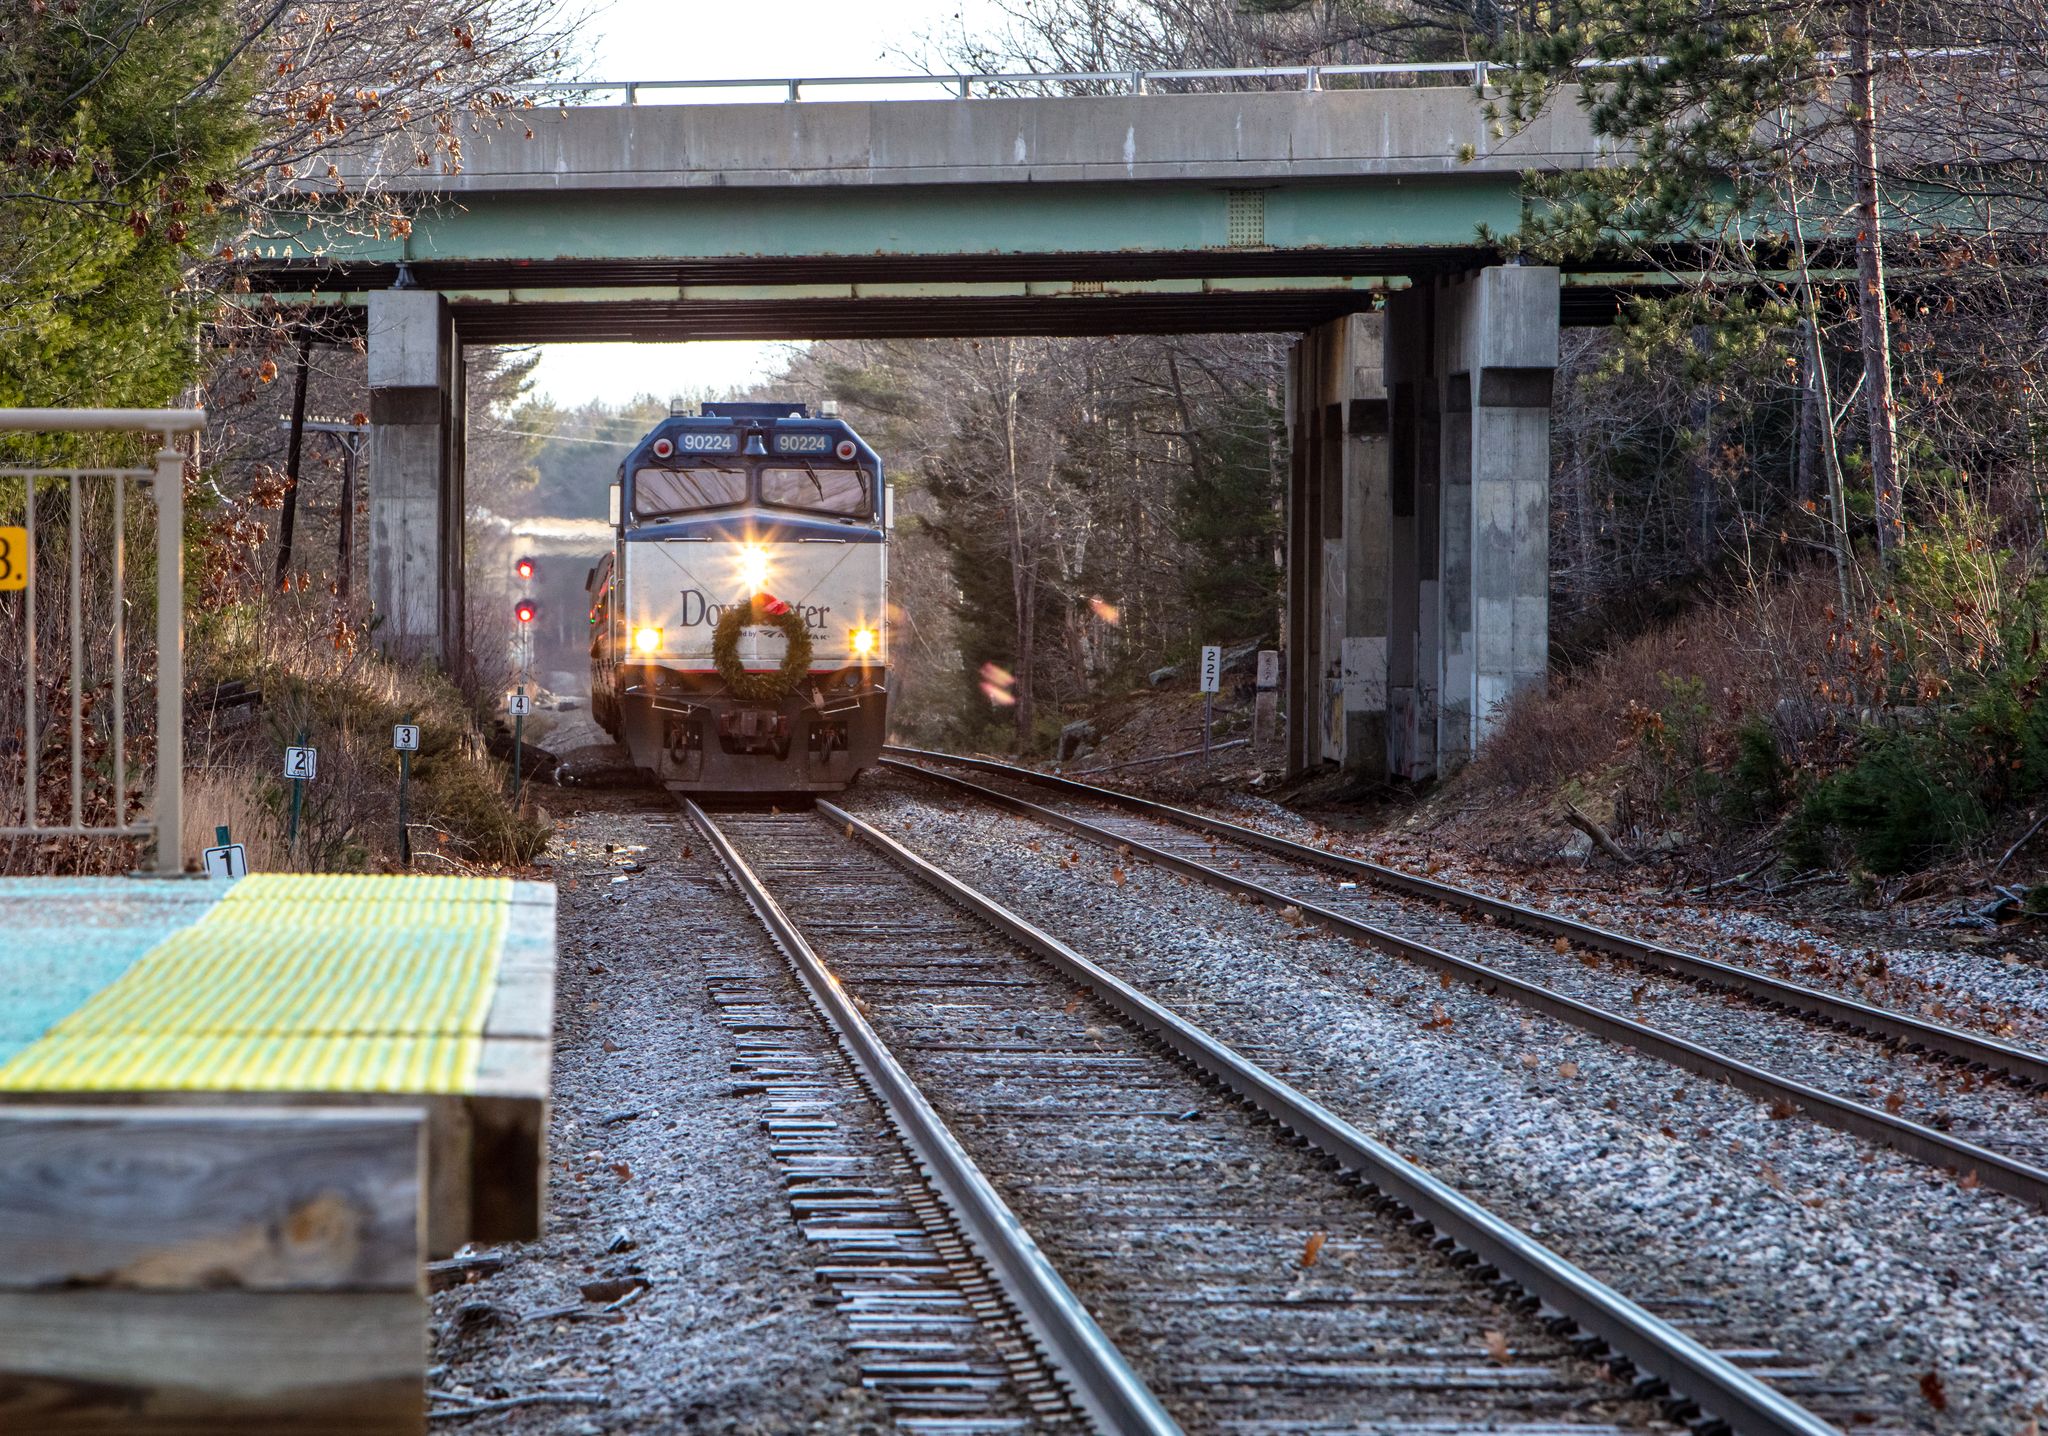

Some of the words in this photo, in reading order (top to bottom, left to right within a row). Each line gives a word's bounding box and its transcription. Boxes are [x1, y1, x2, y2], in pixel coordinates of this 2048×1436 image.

[685, 435, 732, 450] 90224
[780, 436, 826, 451] 90224
[516, 698, 523, 710] 4
[402, 728, 411, 743] 3
[295, 751, 306, 770] 2
[220, 850, 232, 876] 1
